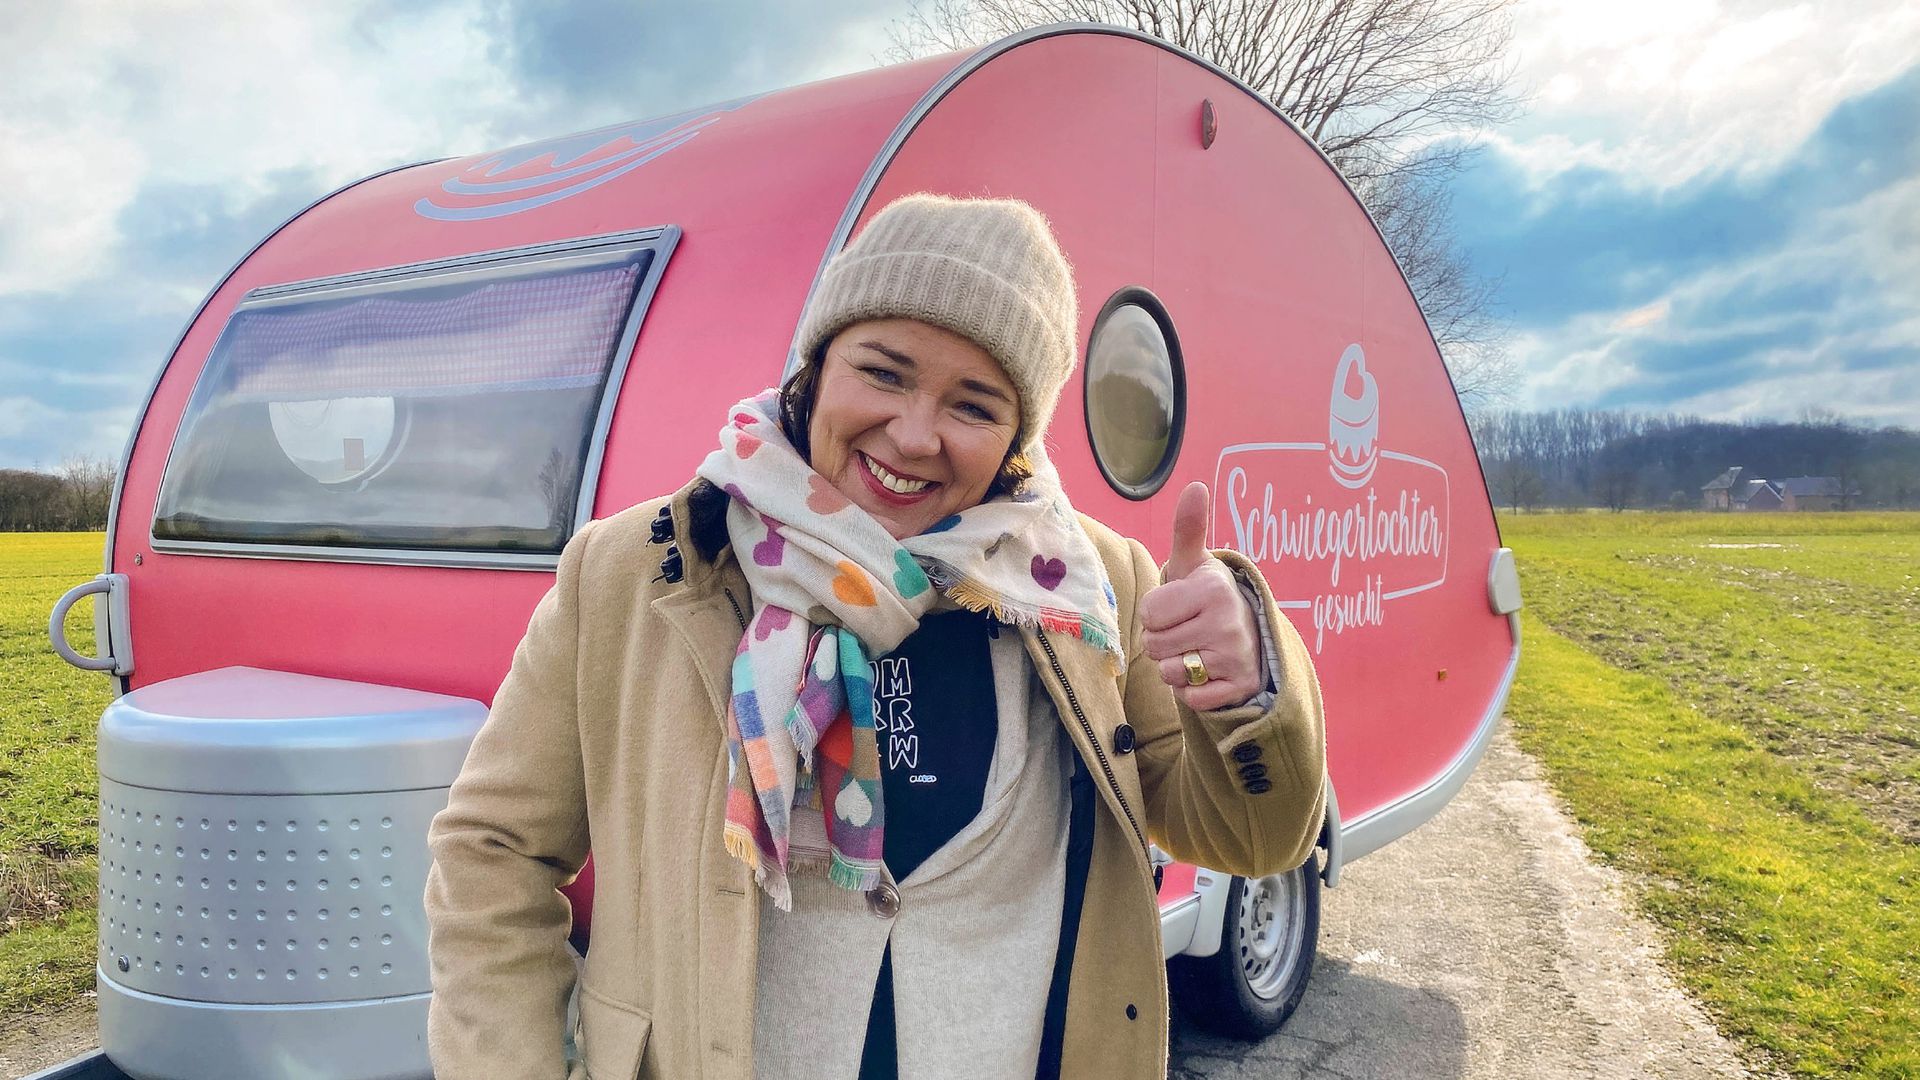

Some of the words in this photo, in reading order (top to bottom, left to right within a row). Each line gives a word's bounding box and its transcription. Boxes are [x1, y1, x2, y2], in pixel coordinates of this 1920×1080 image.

[1225, 466, 1442, 587] Schwiegertochter
[1313, 574, 1384, 655] gesucht
[868, 657, 912, 698] M
